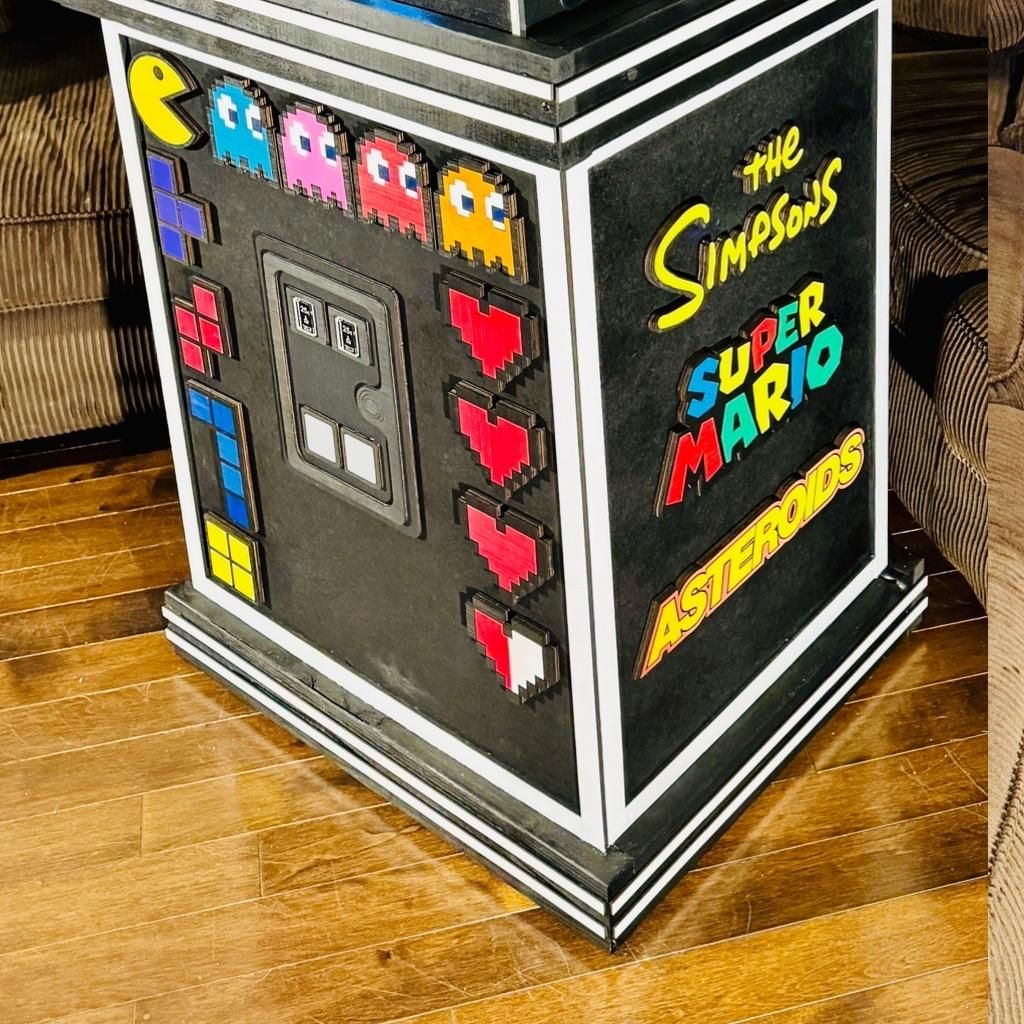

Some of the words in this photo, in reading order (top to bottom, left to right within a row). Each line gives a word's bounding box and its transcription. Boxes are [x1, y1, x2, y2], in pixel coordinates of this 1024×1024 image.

[665, 325, 844, 506] MARIO
[687, 281, 826, 418] SUPER
[640, 428, 865, 679] ASTEROIDS
